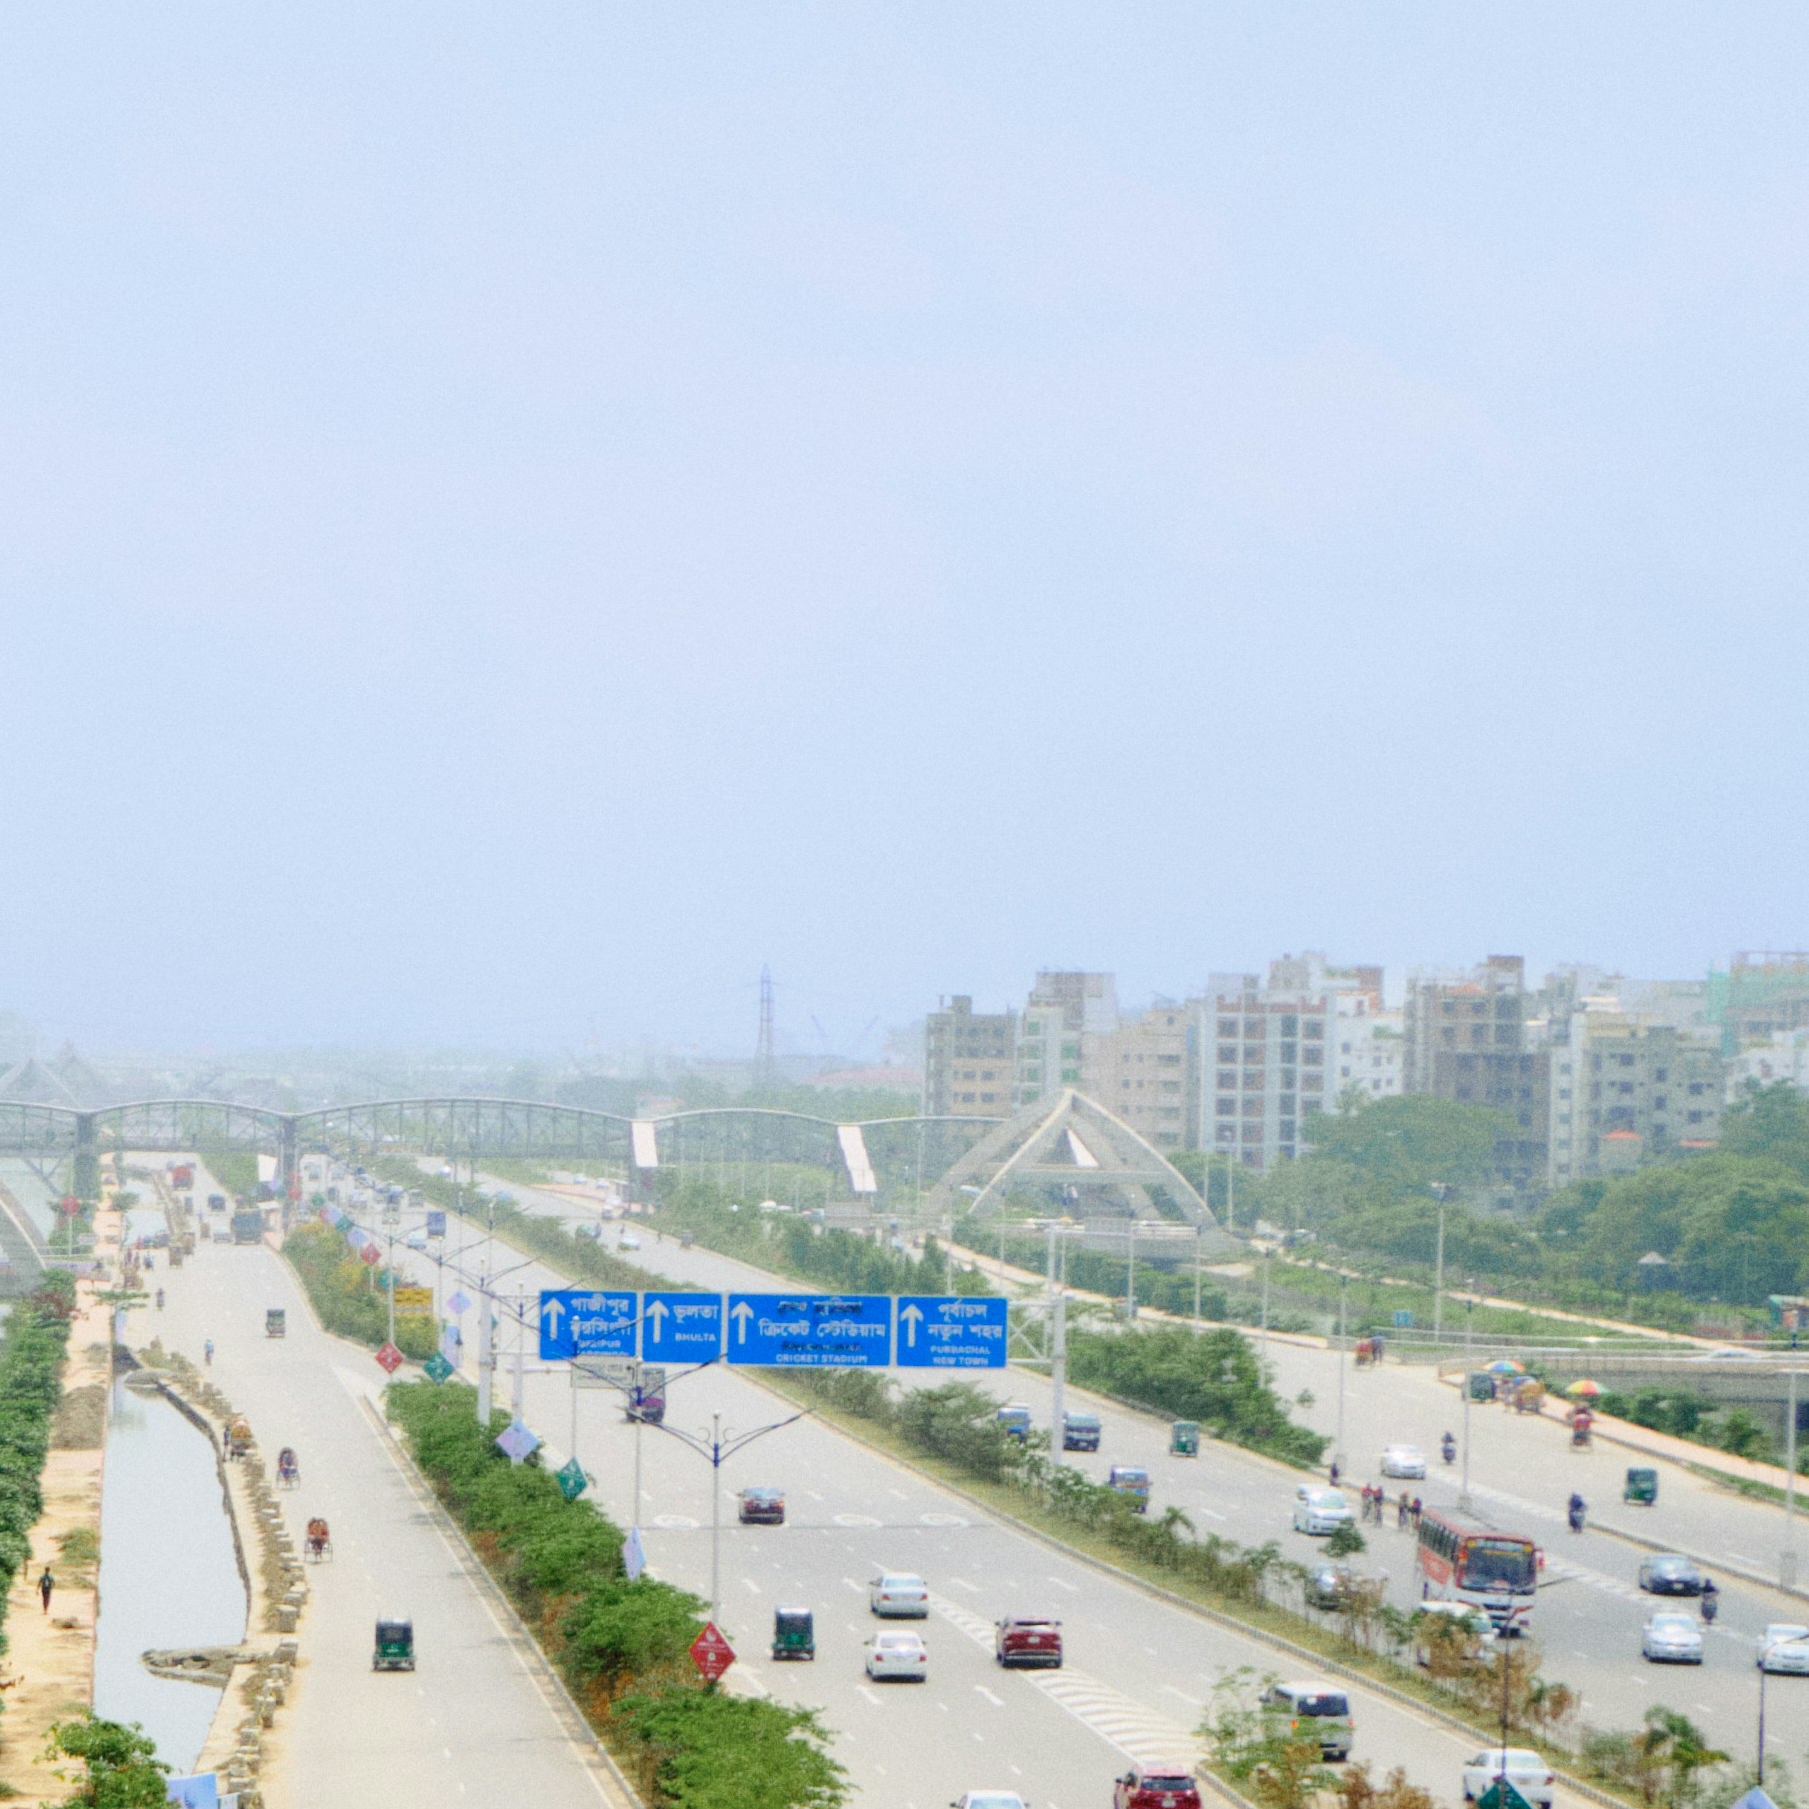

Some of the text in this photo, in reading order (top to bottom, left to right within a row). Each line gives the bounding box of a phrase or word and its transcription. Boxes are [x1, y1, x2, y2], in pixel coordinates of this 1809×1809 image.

[758, 1318, 810, 1337] ক্রিকেট
[675, 1333, 716, 1341] BHULTA
[776, 1354, 868, 1363] CRICKET STADIUM
